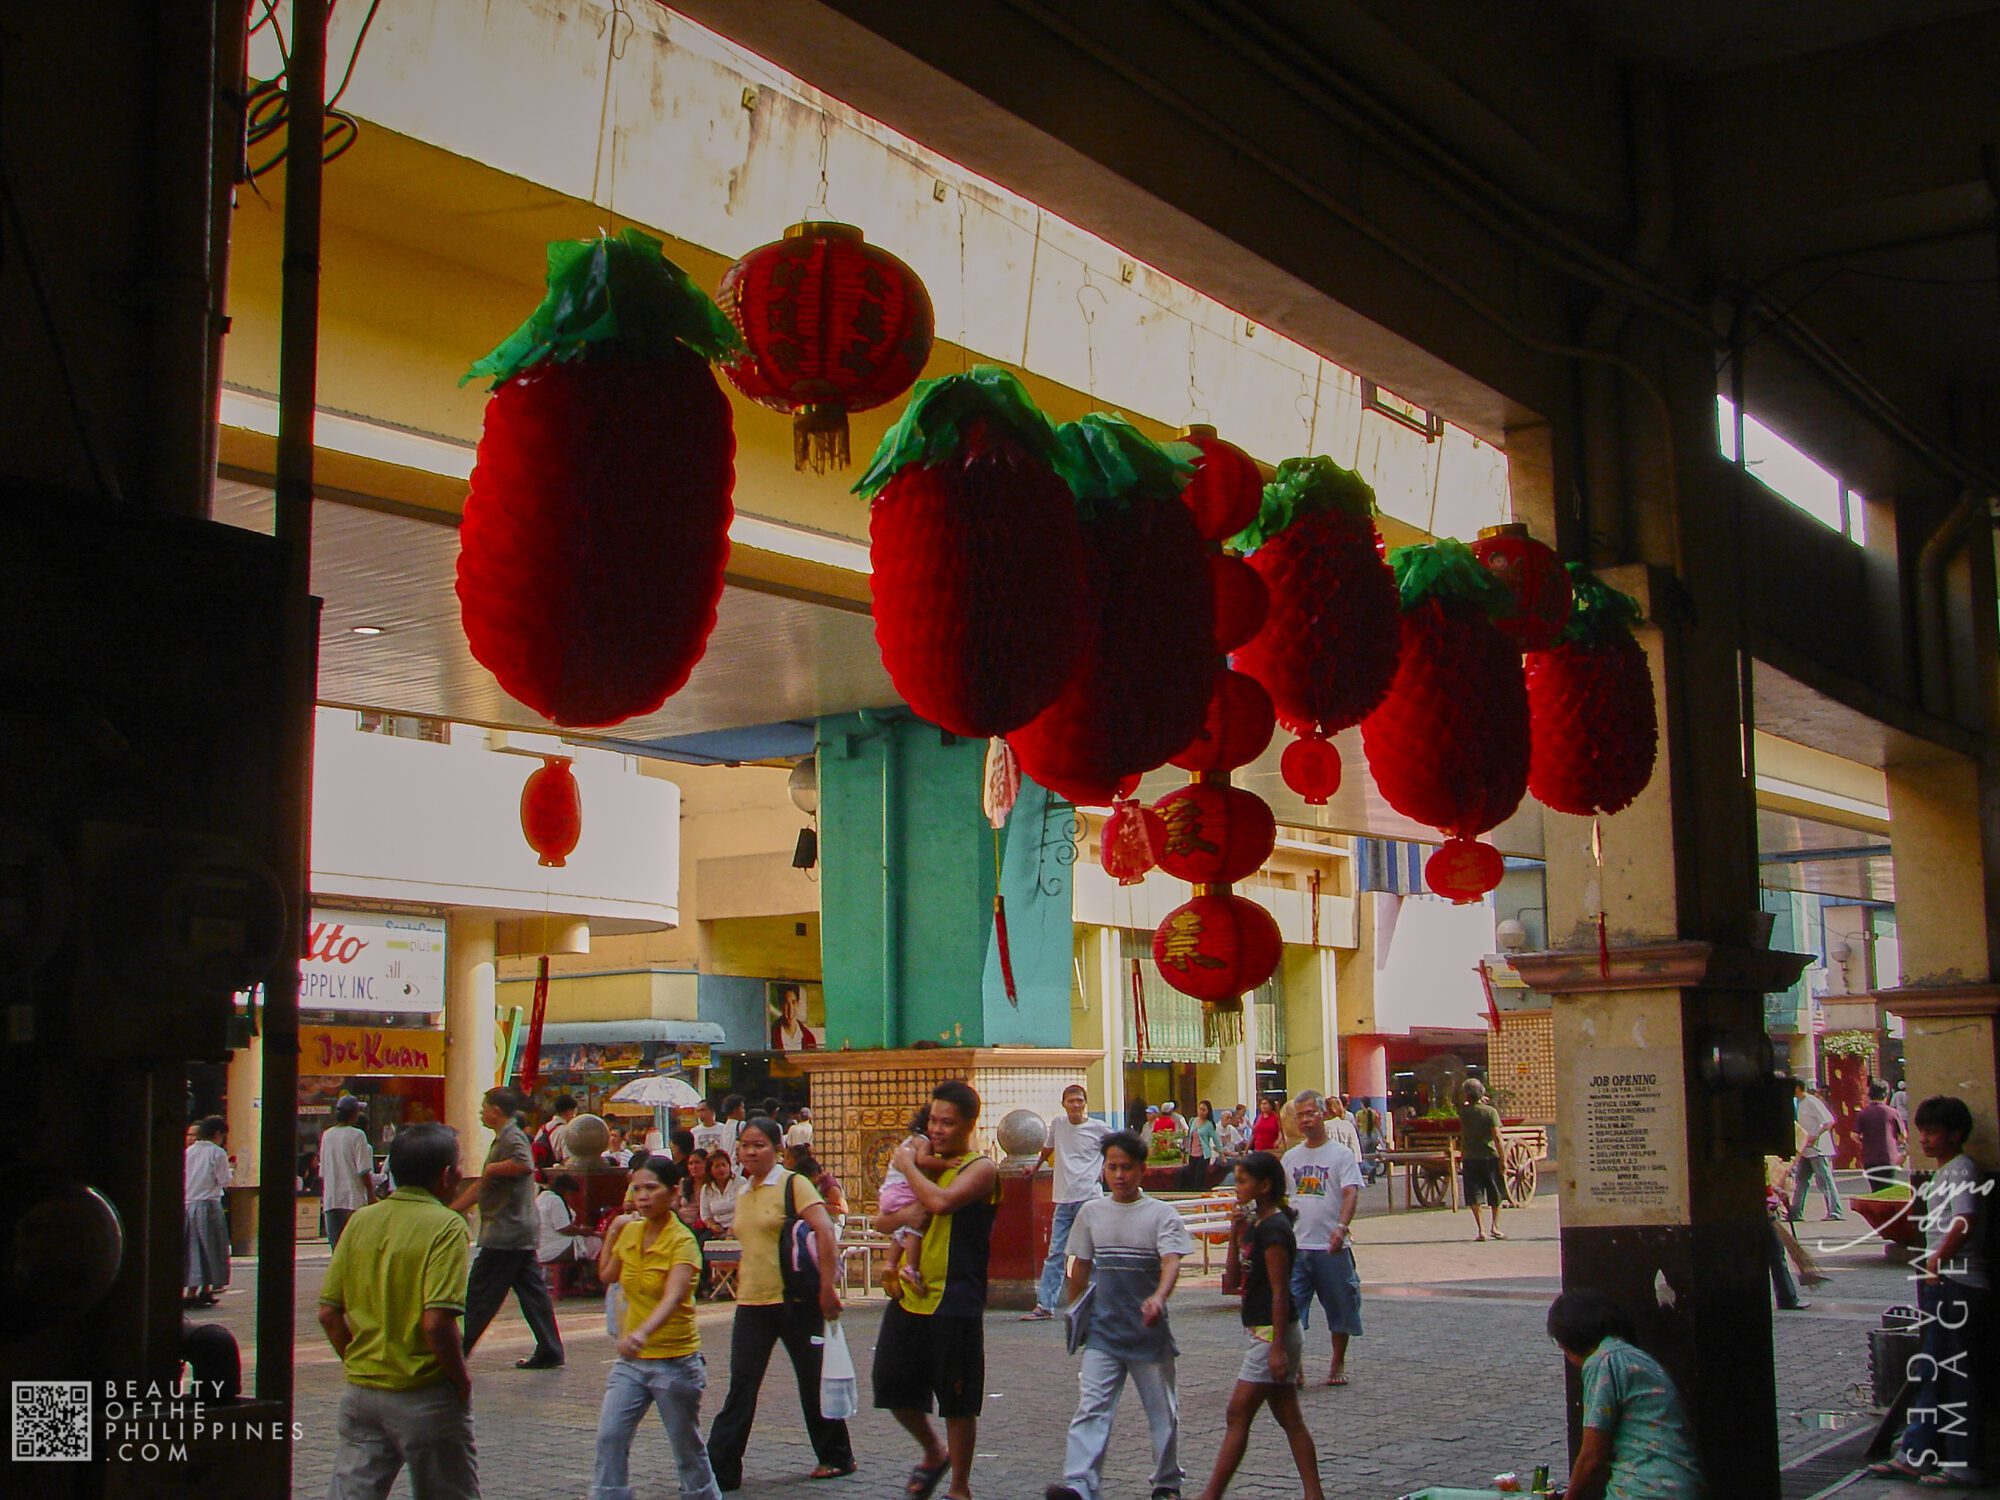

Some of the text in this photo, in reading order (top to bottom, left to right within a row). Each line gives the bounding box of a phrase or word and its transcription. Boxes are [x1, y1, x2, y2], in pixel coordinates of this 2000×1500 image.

[300, 973, 379, 1000] UPPLY. INC.
[1590, 1074, 1656, 1087] JOB OPENING
